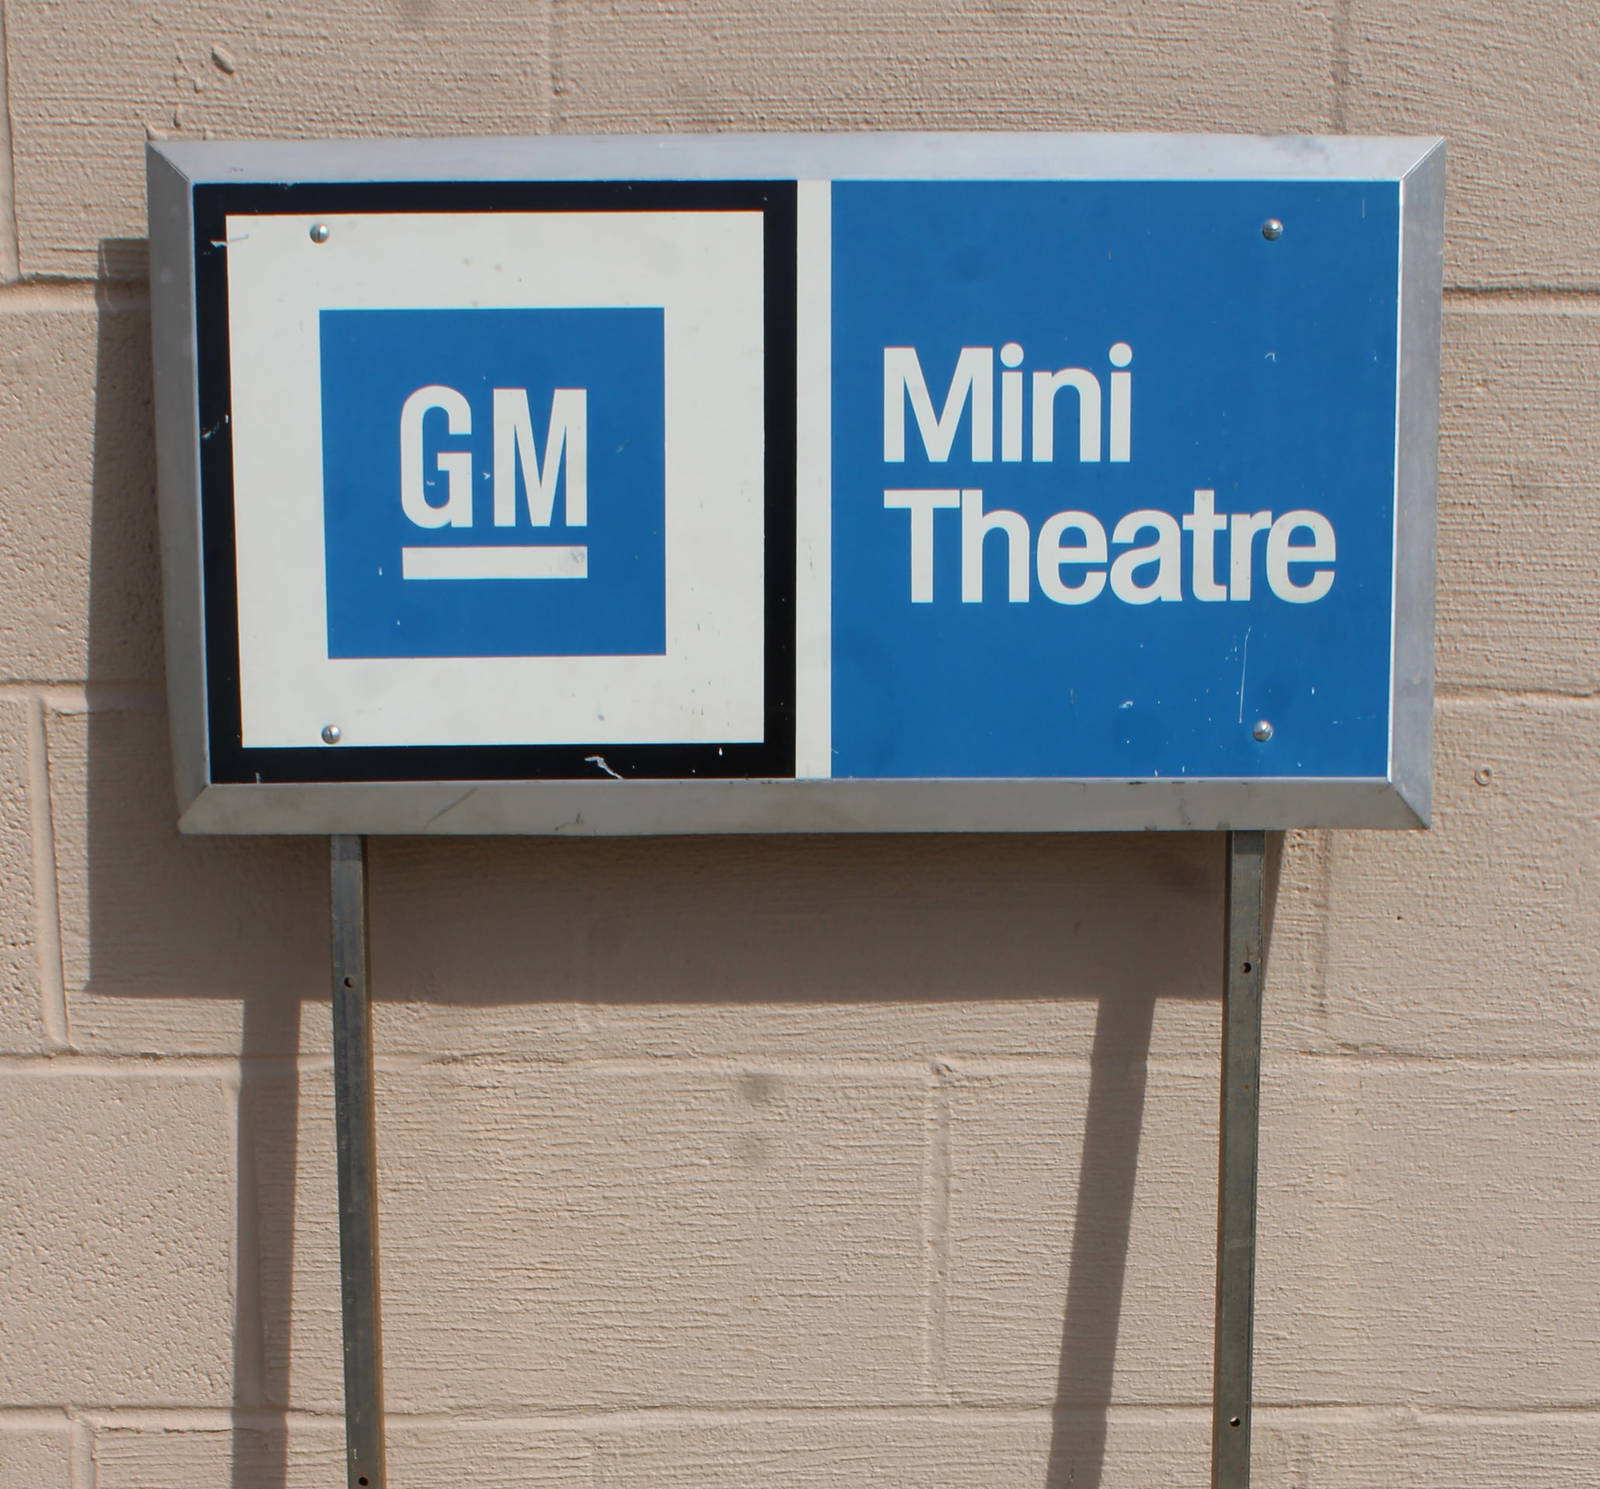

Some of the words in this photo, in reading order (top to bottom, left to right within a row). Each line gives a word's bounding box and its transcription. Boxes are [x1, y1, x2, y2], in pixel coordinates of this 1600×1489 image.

[399, 384, 588, 528] GM
[883, 342, 1133, 462] Mini
[883, 488, 1337, 605] Theatre
